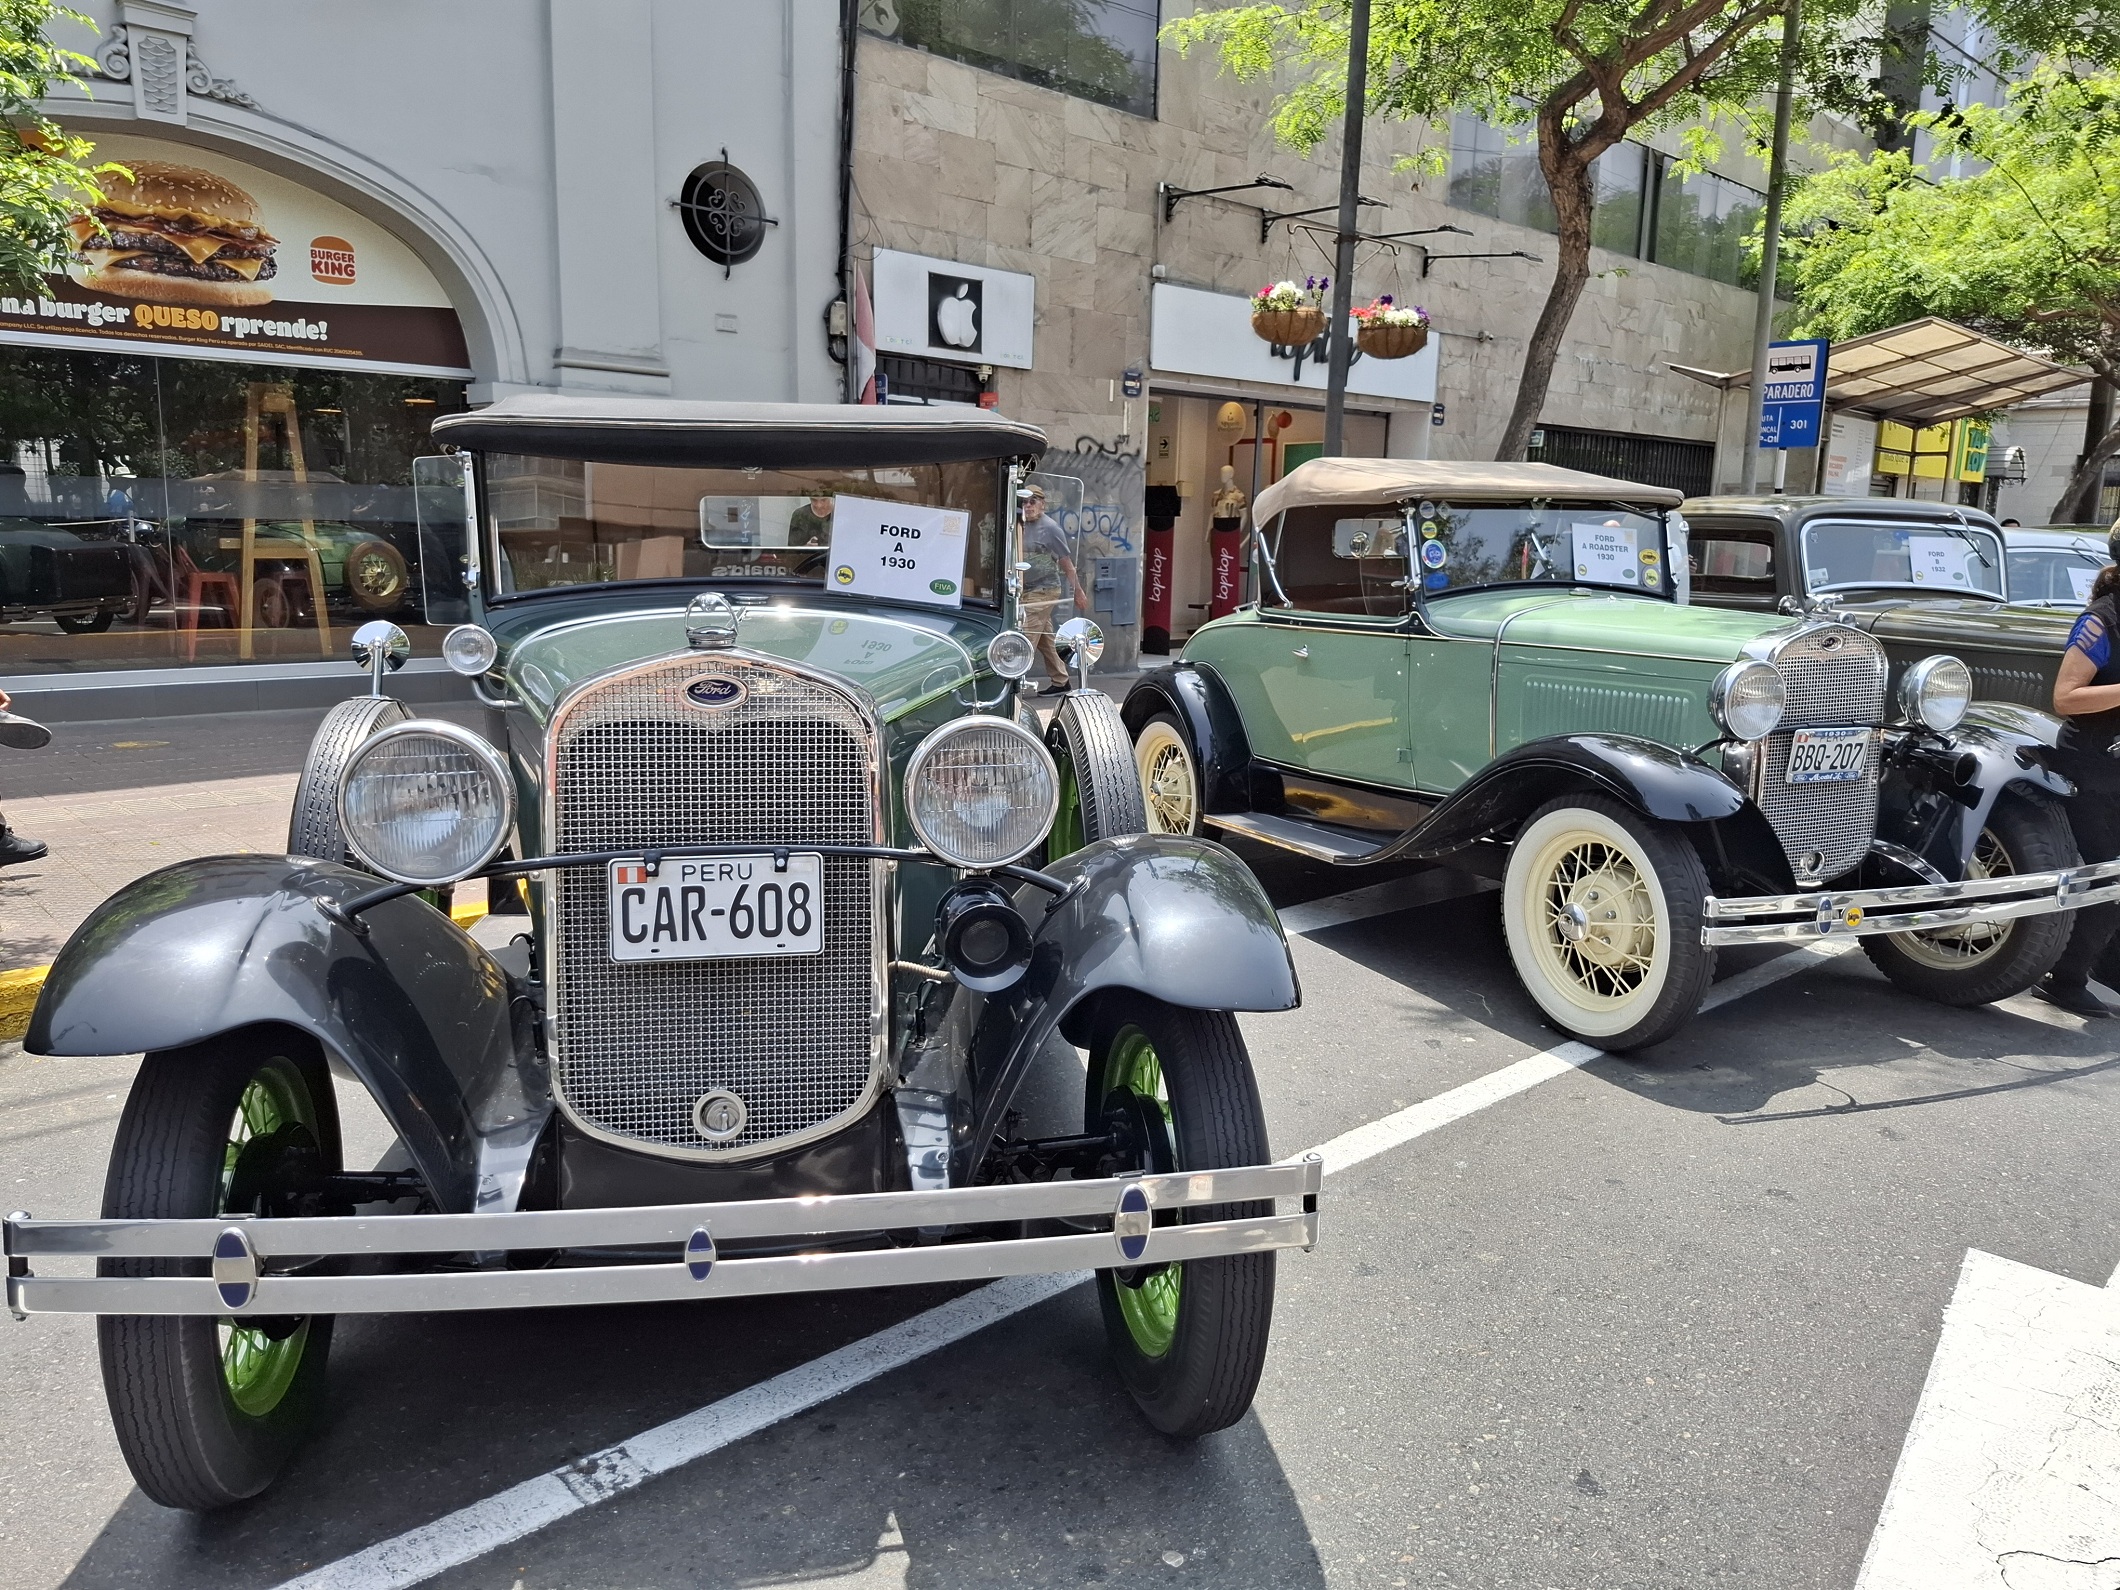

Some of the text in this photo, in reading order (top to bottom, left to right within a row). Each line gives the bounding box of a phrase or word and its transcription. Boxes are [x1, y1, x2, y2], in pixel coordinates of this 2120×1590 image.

[310, 249, 355, 264] BURGER
[311, 259, 356, 277] KING
[38, 295, 130, 327] burger
[134, 304, 219, 331] QUESO
[220, 315, 328, 341] rprende!
[1763, 383, 1815, 400] PARADERO
[1761, 414, 1808, 430] UTA 301
[880, 524, 921, 540] FORD
[1594, 534, 1615, 542] FORD
[893, 542, 904, 553] A
[1589, 543, 1629, 553] ROADSTER
[880, 556, 916, 570] 1930
[1597, 553, 1615, 561] 1930
[1149, 547, 1167, 602] topitop
[1216, 547, 1234, 600] topitop
[934, 583, 952, 591] FIVA
[694, 681, 731, 695] Ford
[1791, 742, 1864, 772] BBQ-207
[682, 863, 753, 883] PERU
[621, 881, 812, 944] CAR-608
